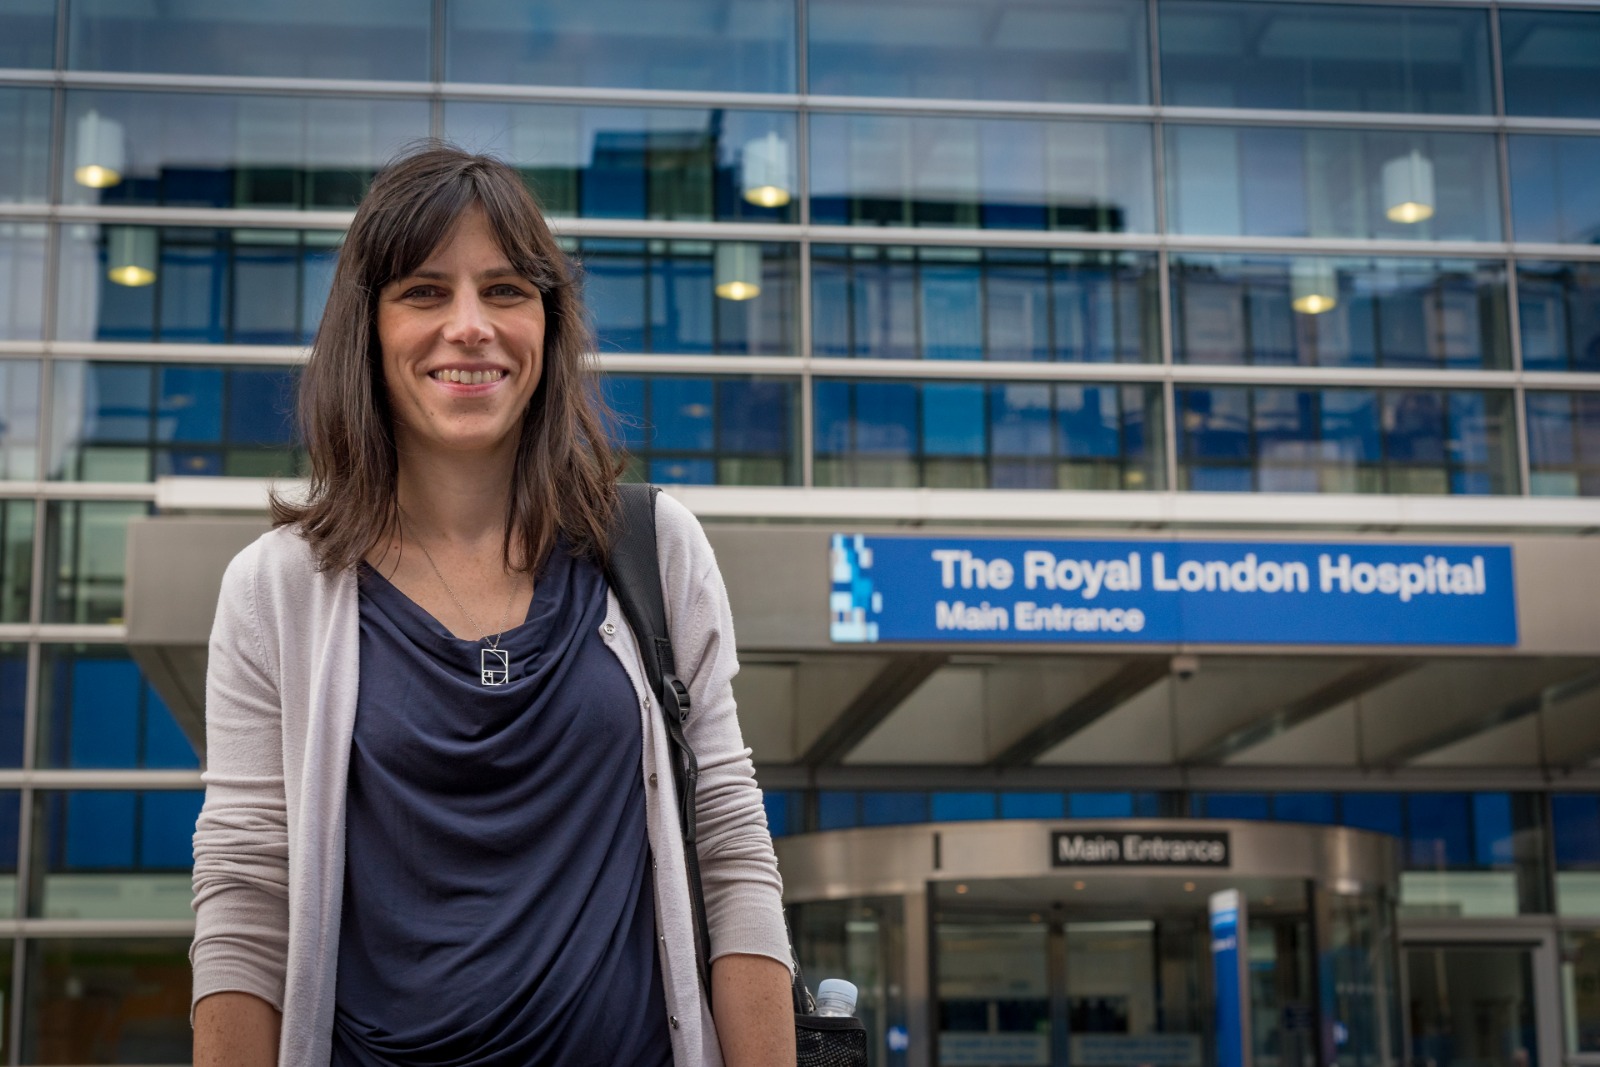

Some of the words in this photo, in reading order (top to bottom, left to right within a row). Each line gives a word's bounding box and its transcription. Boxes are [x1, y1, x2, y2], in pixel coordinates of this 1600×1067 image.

[932, 550, 1014, 589] The
[1024, 550, 1141, 599] Royal
[1152, 552, 1309, 592] London
[1319, 554, 1485, 601] Hospital
[936, 601, 1008, 630] Main
[1015, 601, 1145, 632] Entrance
[1058, 835, 1120, 861] Main
[1123, 835, 1225, 862] Entrance
